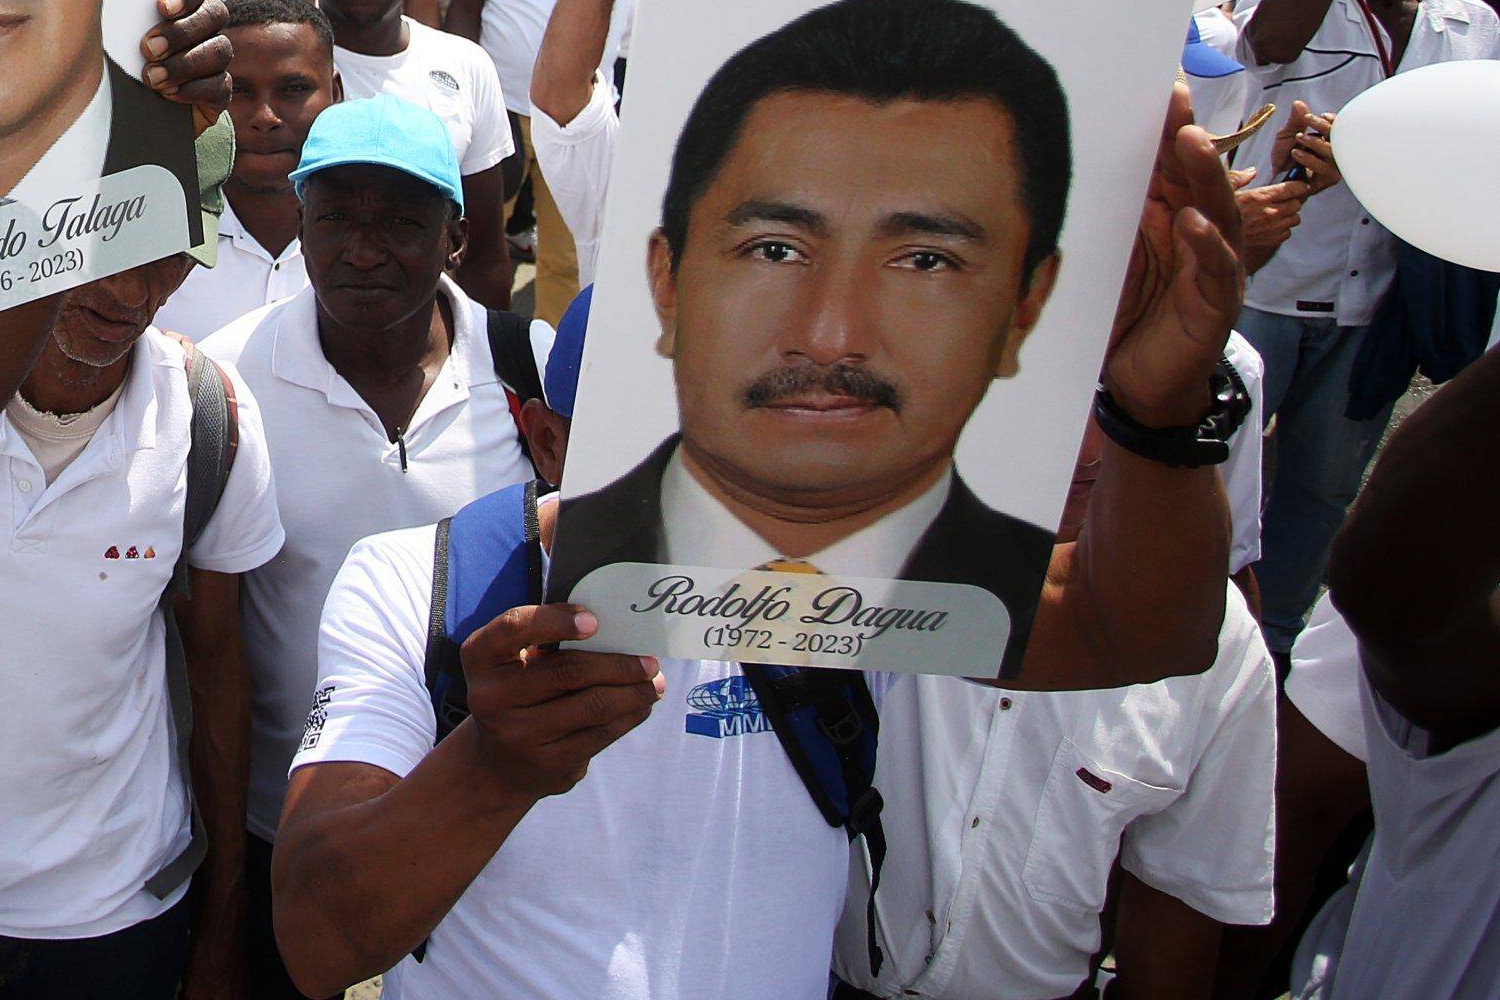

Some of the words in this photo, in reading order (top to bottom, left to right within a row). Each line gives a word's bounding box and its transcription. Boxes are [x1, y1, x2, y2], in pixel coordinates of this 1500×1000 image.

[37, 192, 148, 249] Talaga
[29, 247, 84, 285] 2023)
[630, 575, 791, 630] Rodolfo
[799, 586, 948, 640] Dagua
[703, 625, 772, 650] (1972
[794, 631, 865, 658] 2023)
